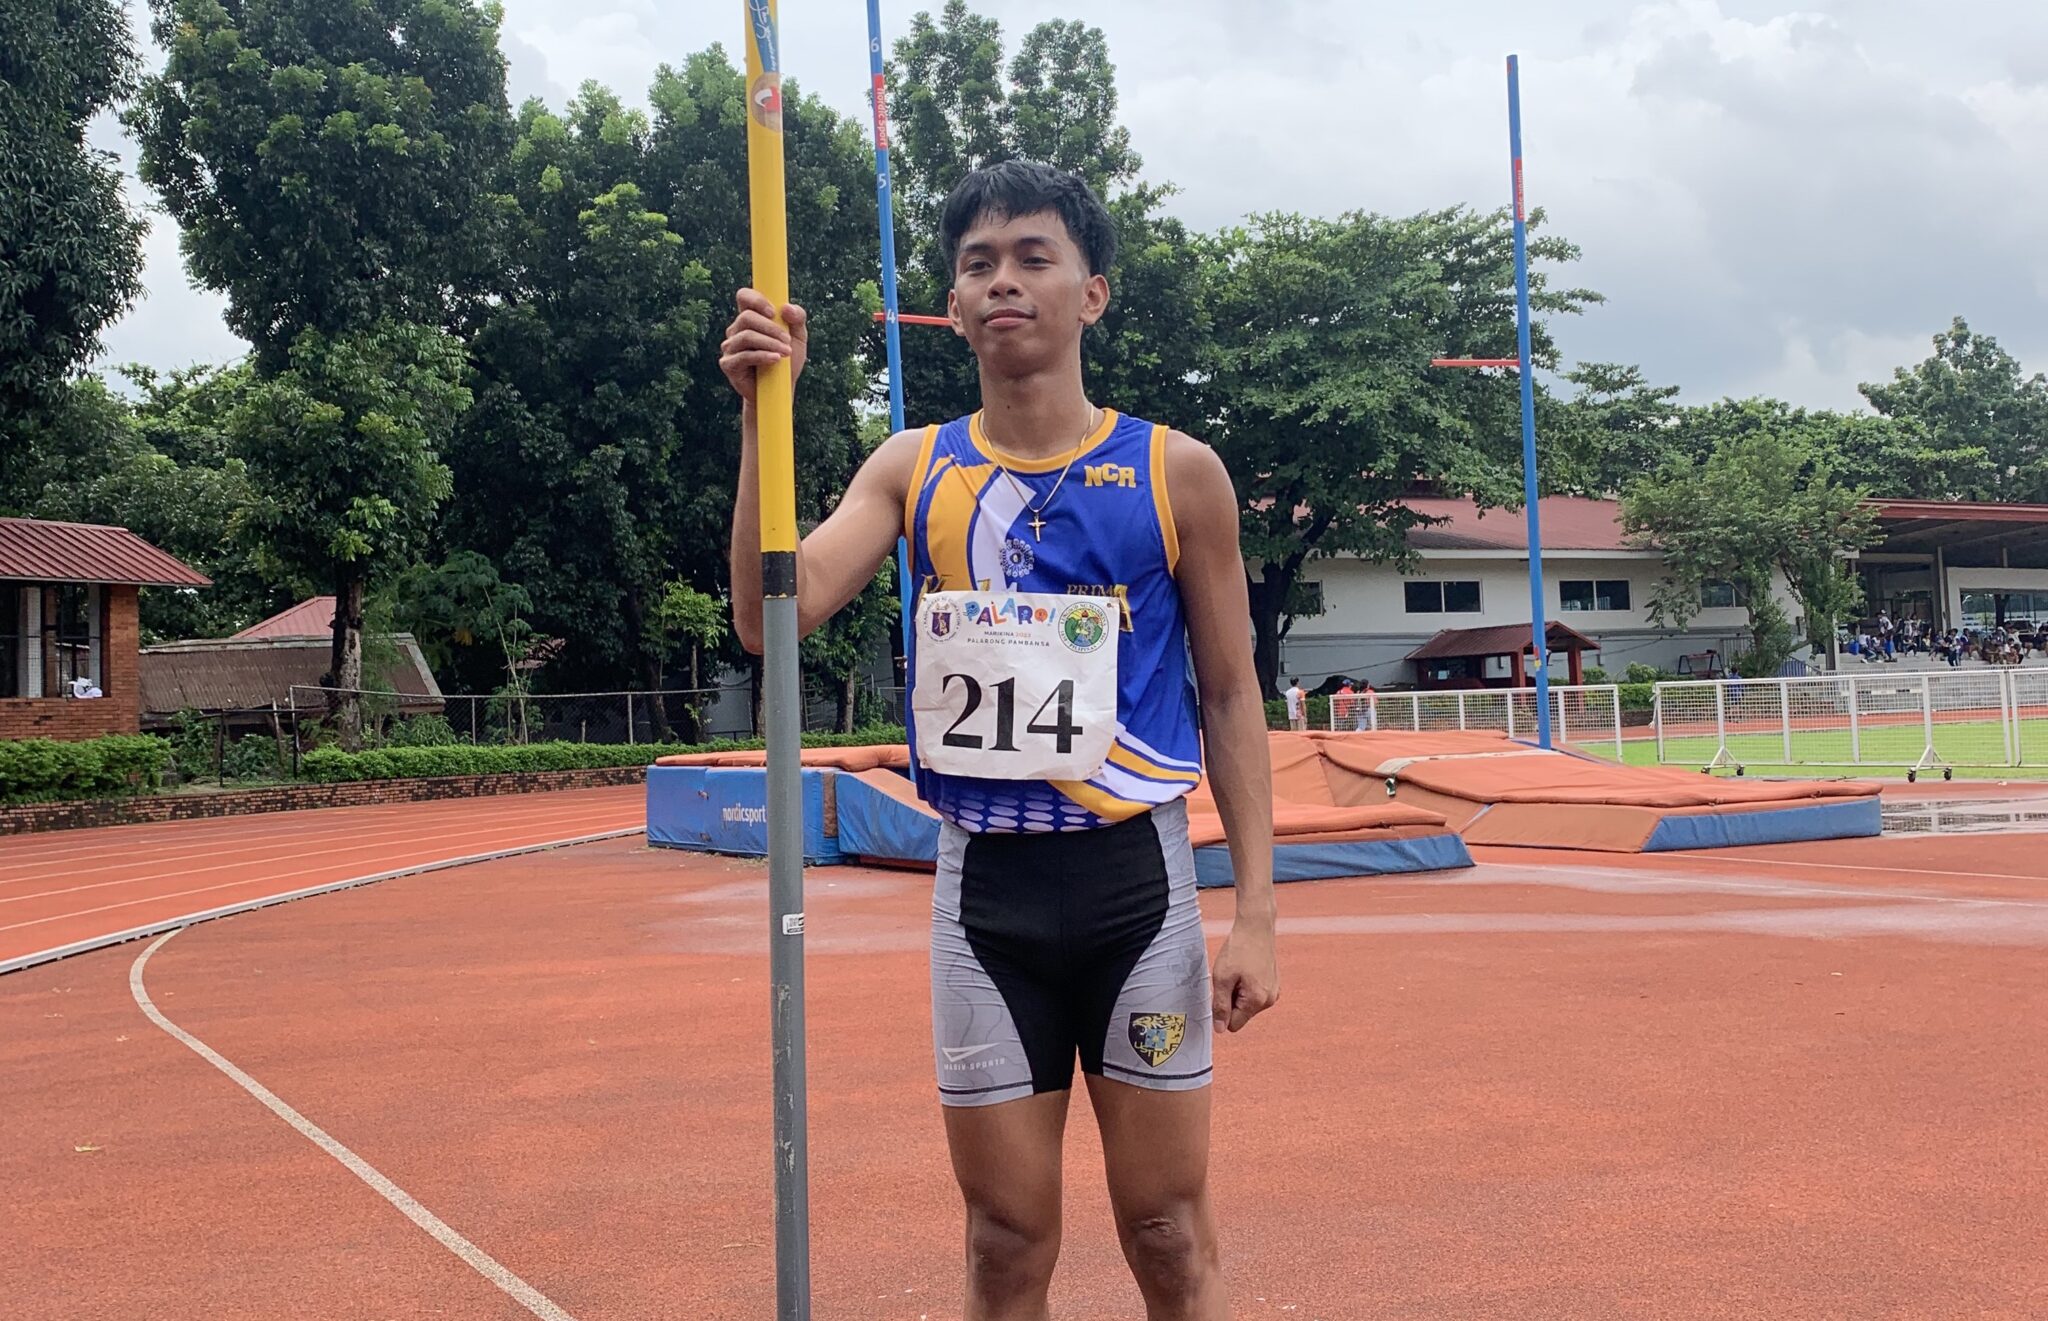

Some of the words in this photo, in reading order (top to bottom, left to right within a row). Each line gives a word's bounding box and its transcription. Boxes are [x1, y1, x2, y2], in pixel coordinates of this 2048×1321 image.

[871, 37, 879, 52] 6
[878, 173, 886, 189] 5
[887, 308, 896, 324] 4
[1084, 463, 1136, 488] NCR
[963, 597, 1056, 627] PALARO!
[942, 673, 1083, 754] 214
[723, 802, 766, 827] nordicsport
[969, 1057, 1006, 1070] SPORTS
